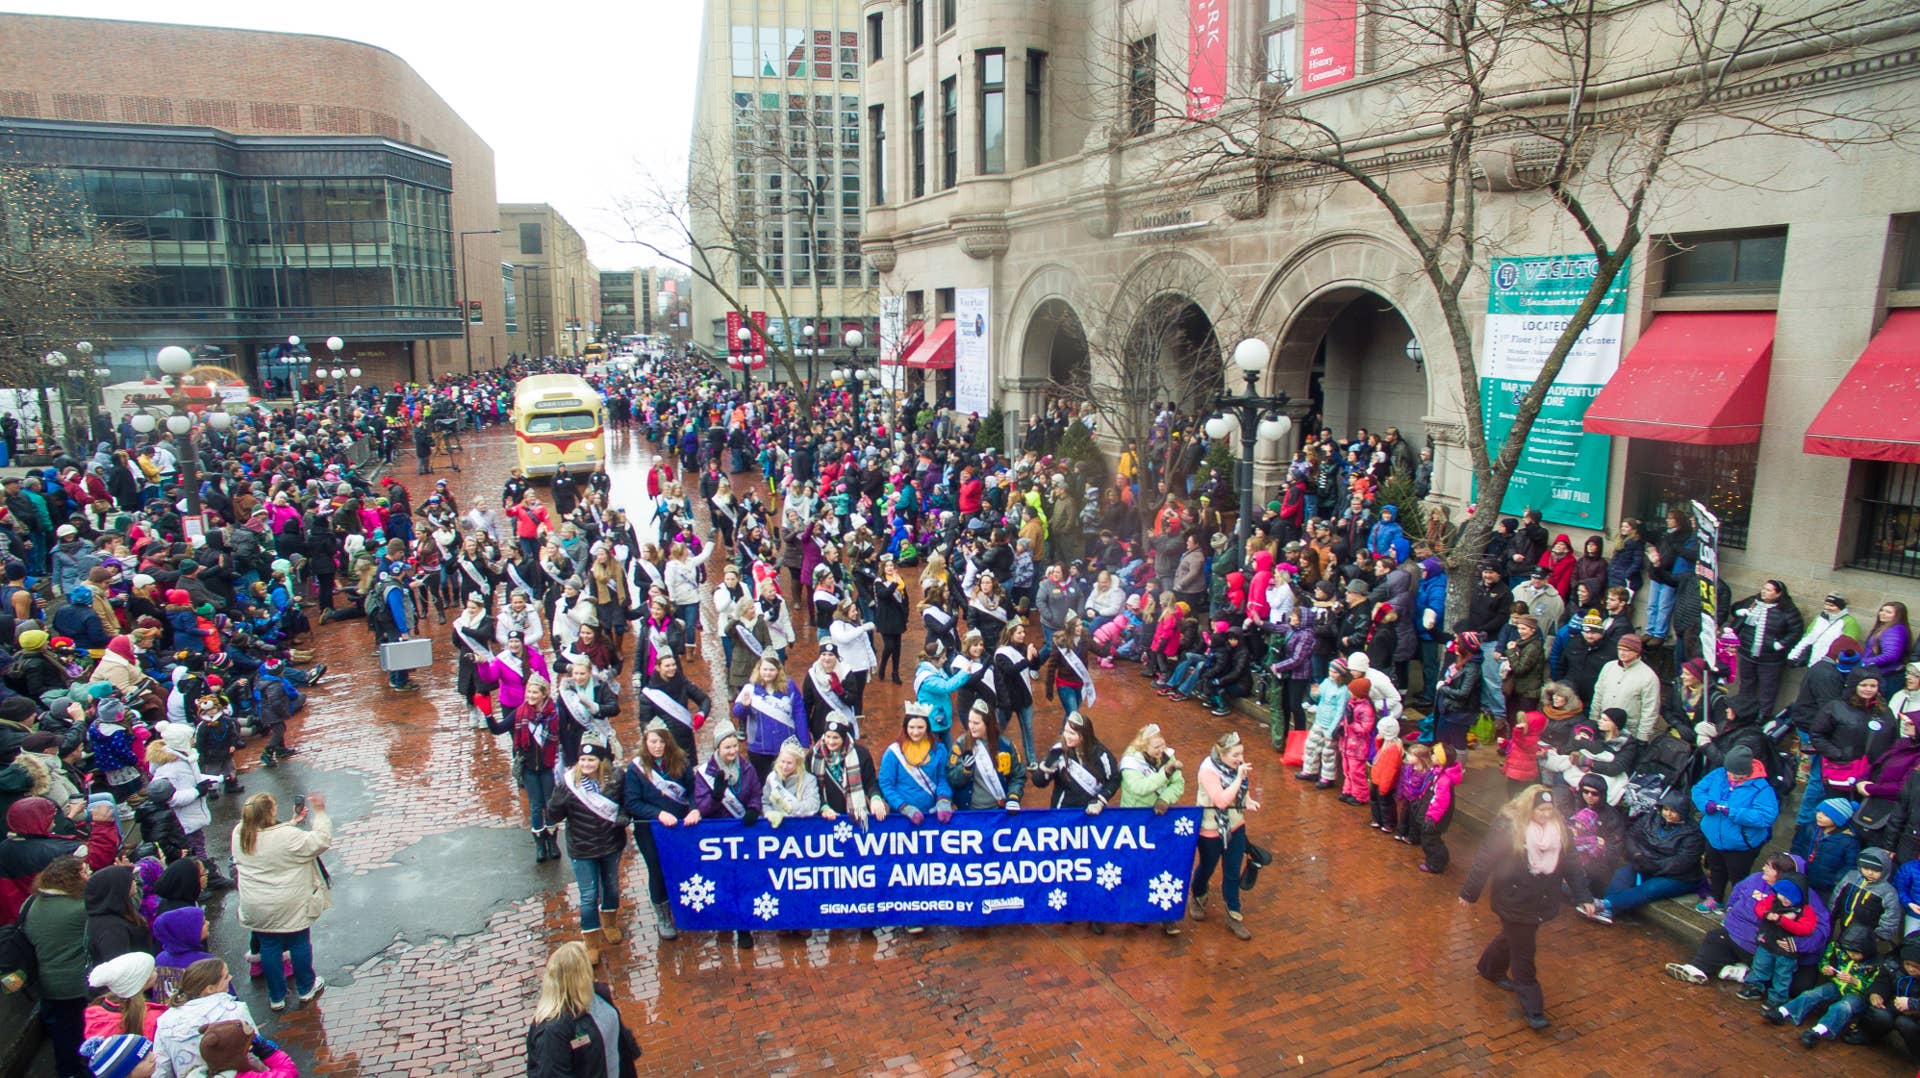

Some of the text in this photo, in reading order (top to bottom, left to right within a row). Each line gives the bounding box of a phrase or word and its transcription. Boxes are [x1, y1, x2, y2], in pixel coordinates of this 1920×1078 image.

[1308, 66, 1347, 83] Community
[698, 825, 1156, 861] ST. PAUL WINTER CARNIVAL
[767, 857, 1093, 891] VISITING AMBASSADORS
[819, 902, 875, 914] SIGNAGE
[876, 899, 954, 912] SPONSORED
[955, 900, 974, 912] BY
